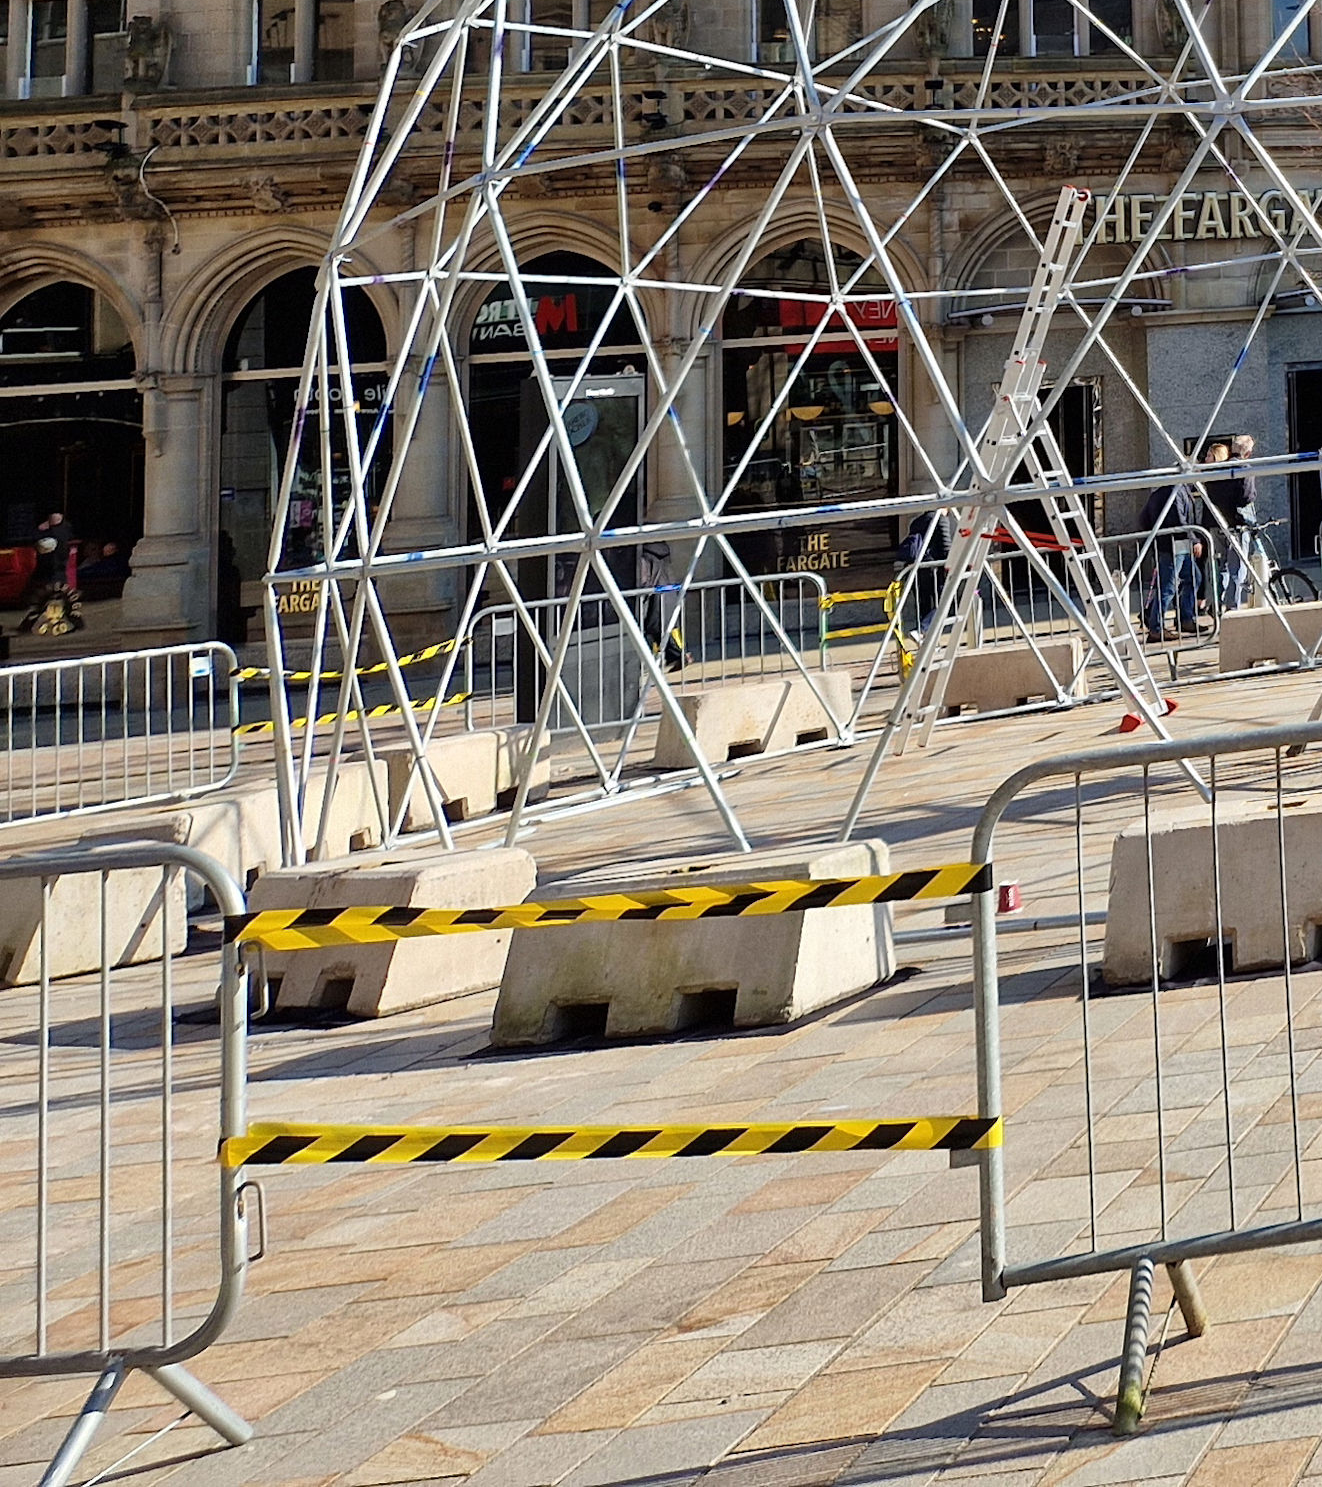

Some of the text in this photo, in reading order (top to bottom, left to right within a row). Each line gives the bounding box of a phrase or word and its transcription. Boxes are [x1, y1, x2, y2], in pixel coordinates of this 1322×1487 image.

[1074, 194, 1156, 245] HE
[797, 532, 831, 552] THE
[776, 549, 851, 572] FARGATE
